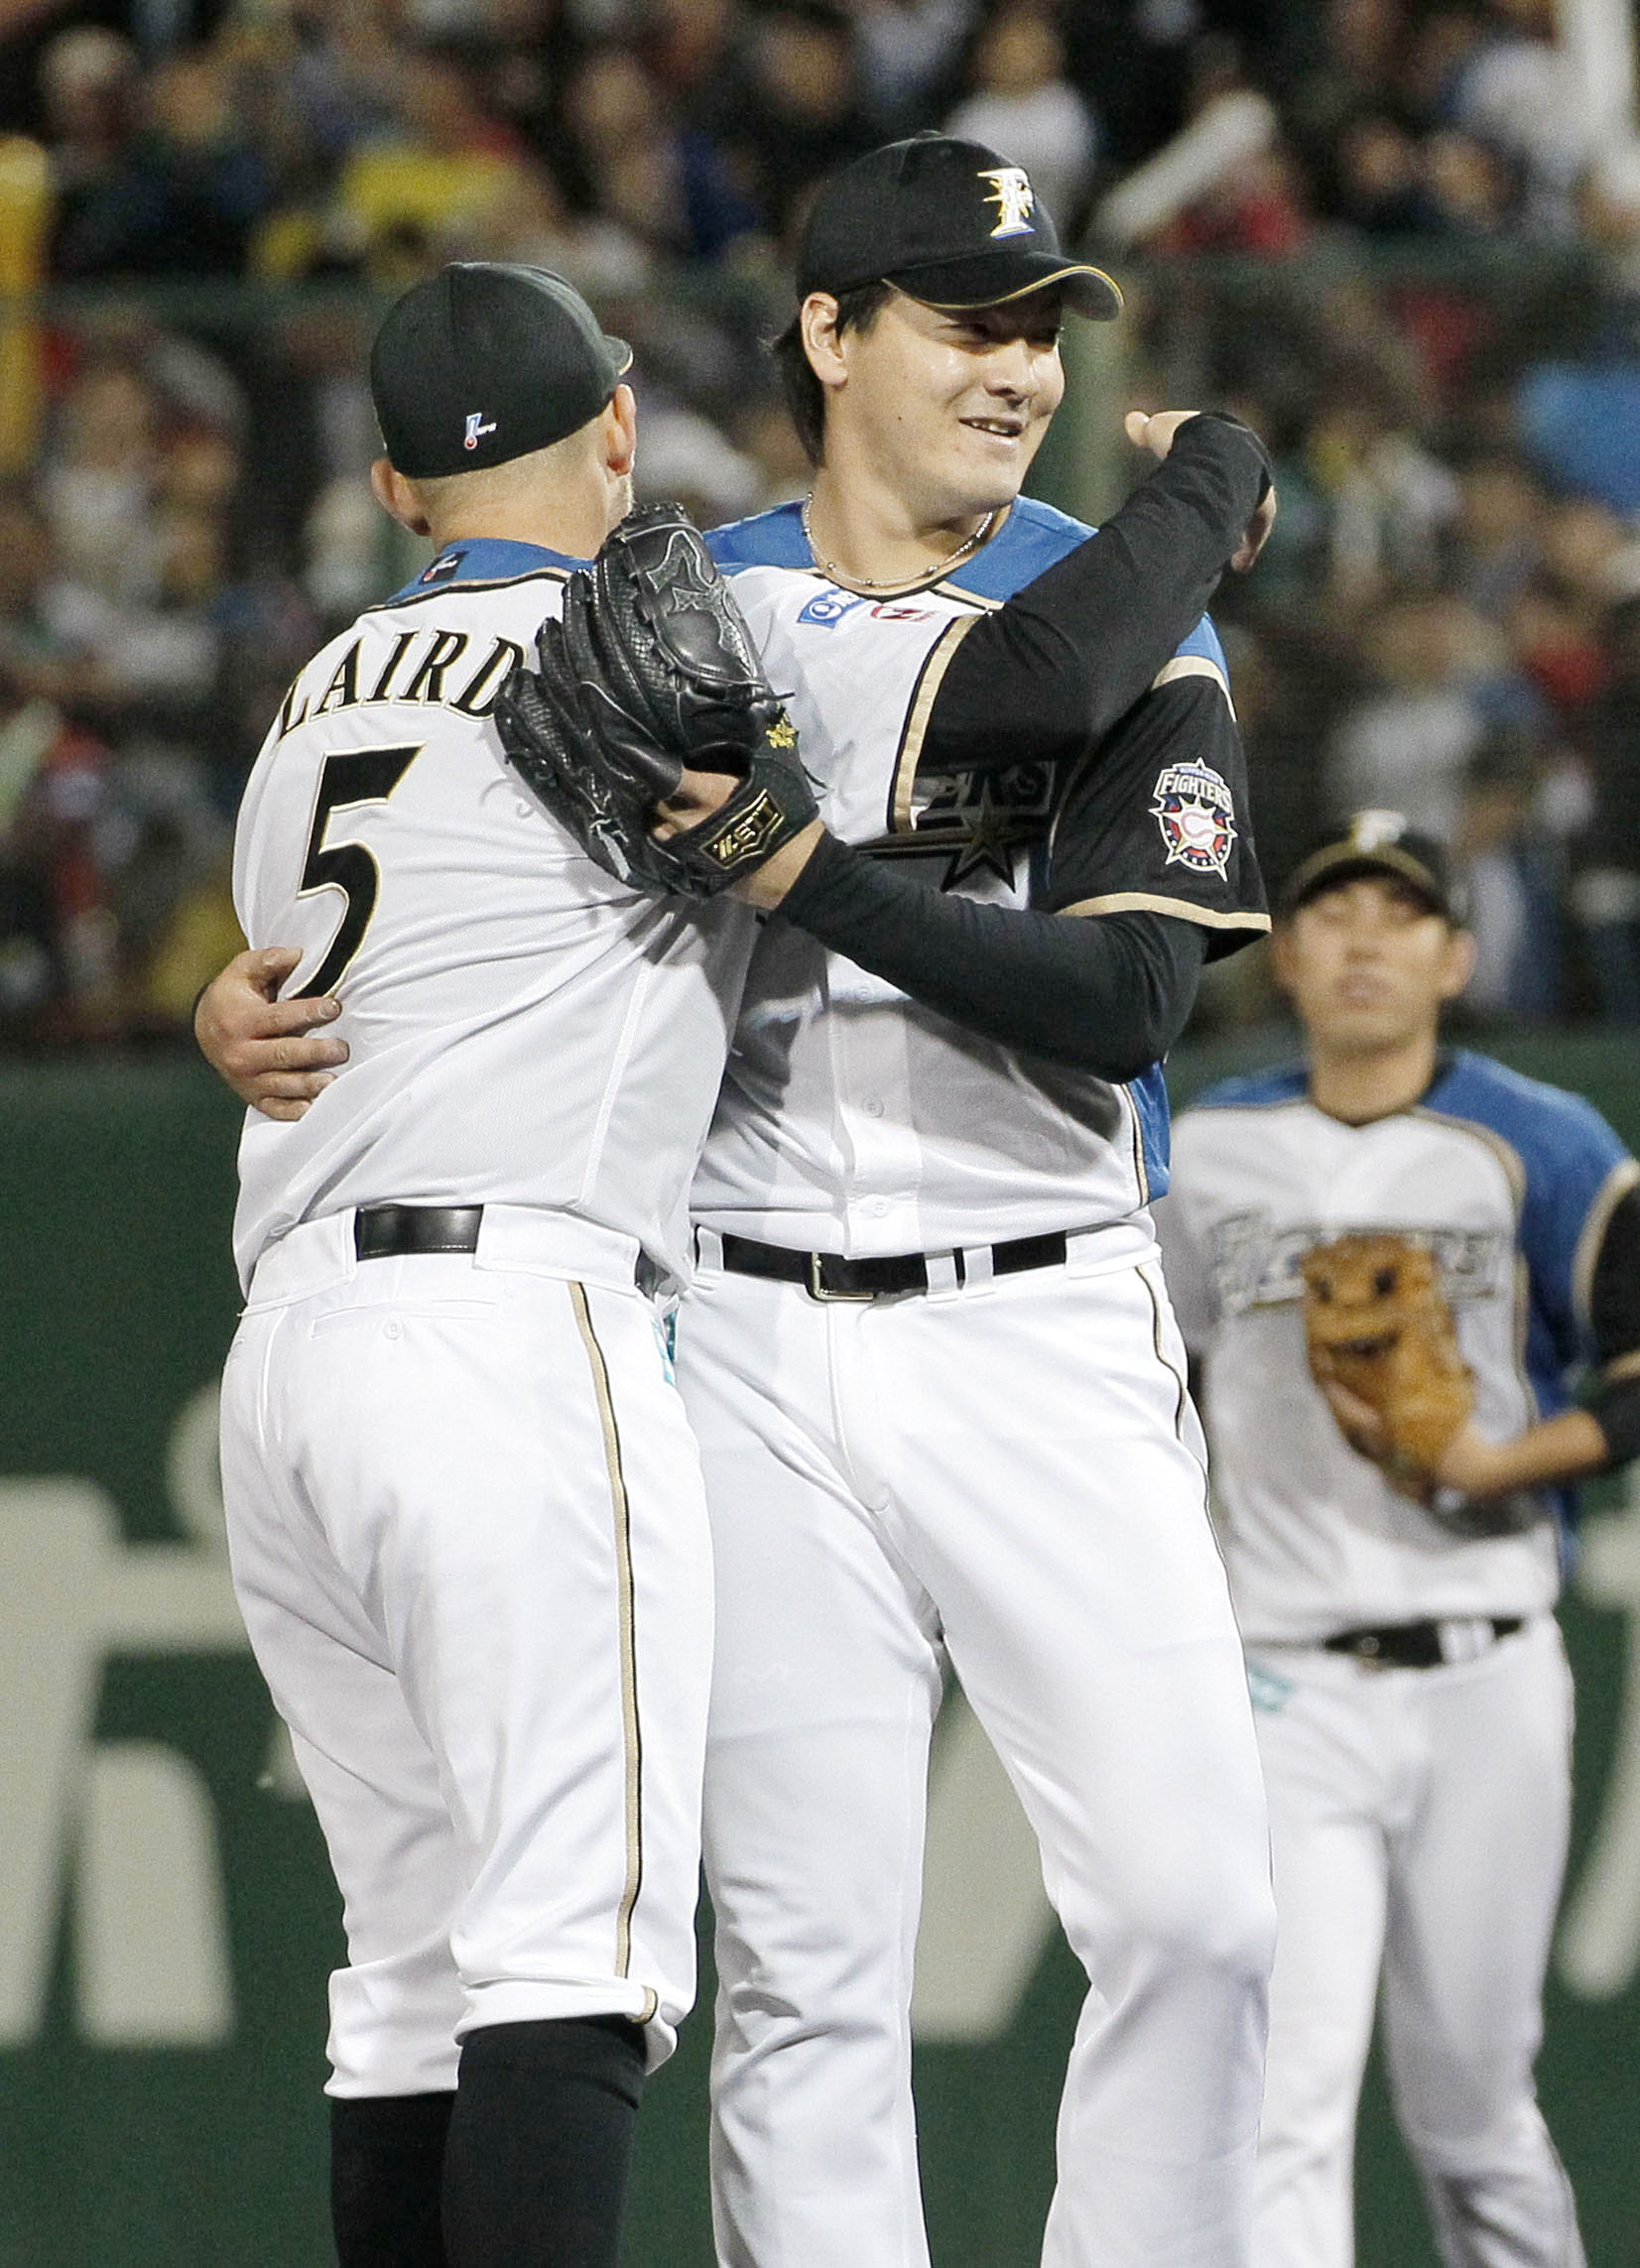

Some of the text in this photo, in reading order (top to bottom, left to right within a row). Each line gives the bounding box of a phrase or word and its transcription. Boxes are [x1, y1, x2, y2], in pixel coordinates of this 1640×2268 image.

[977, 167, 1036, 240] F
[278, 628, 526, 740] LAIRD
[1158, 773, 1232, 816] FIGHTERS
[286, 741, 426, 1000] 5
